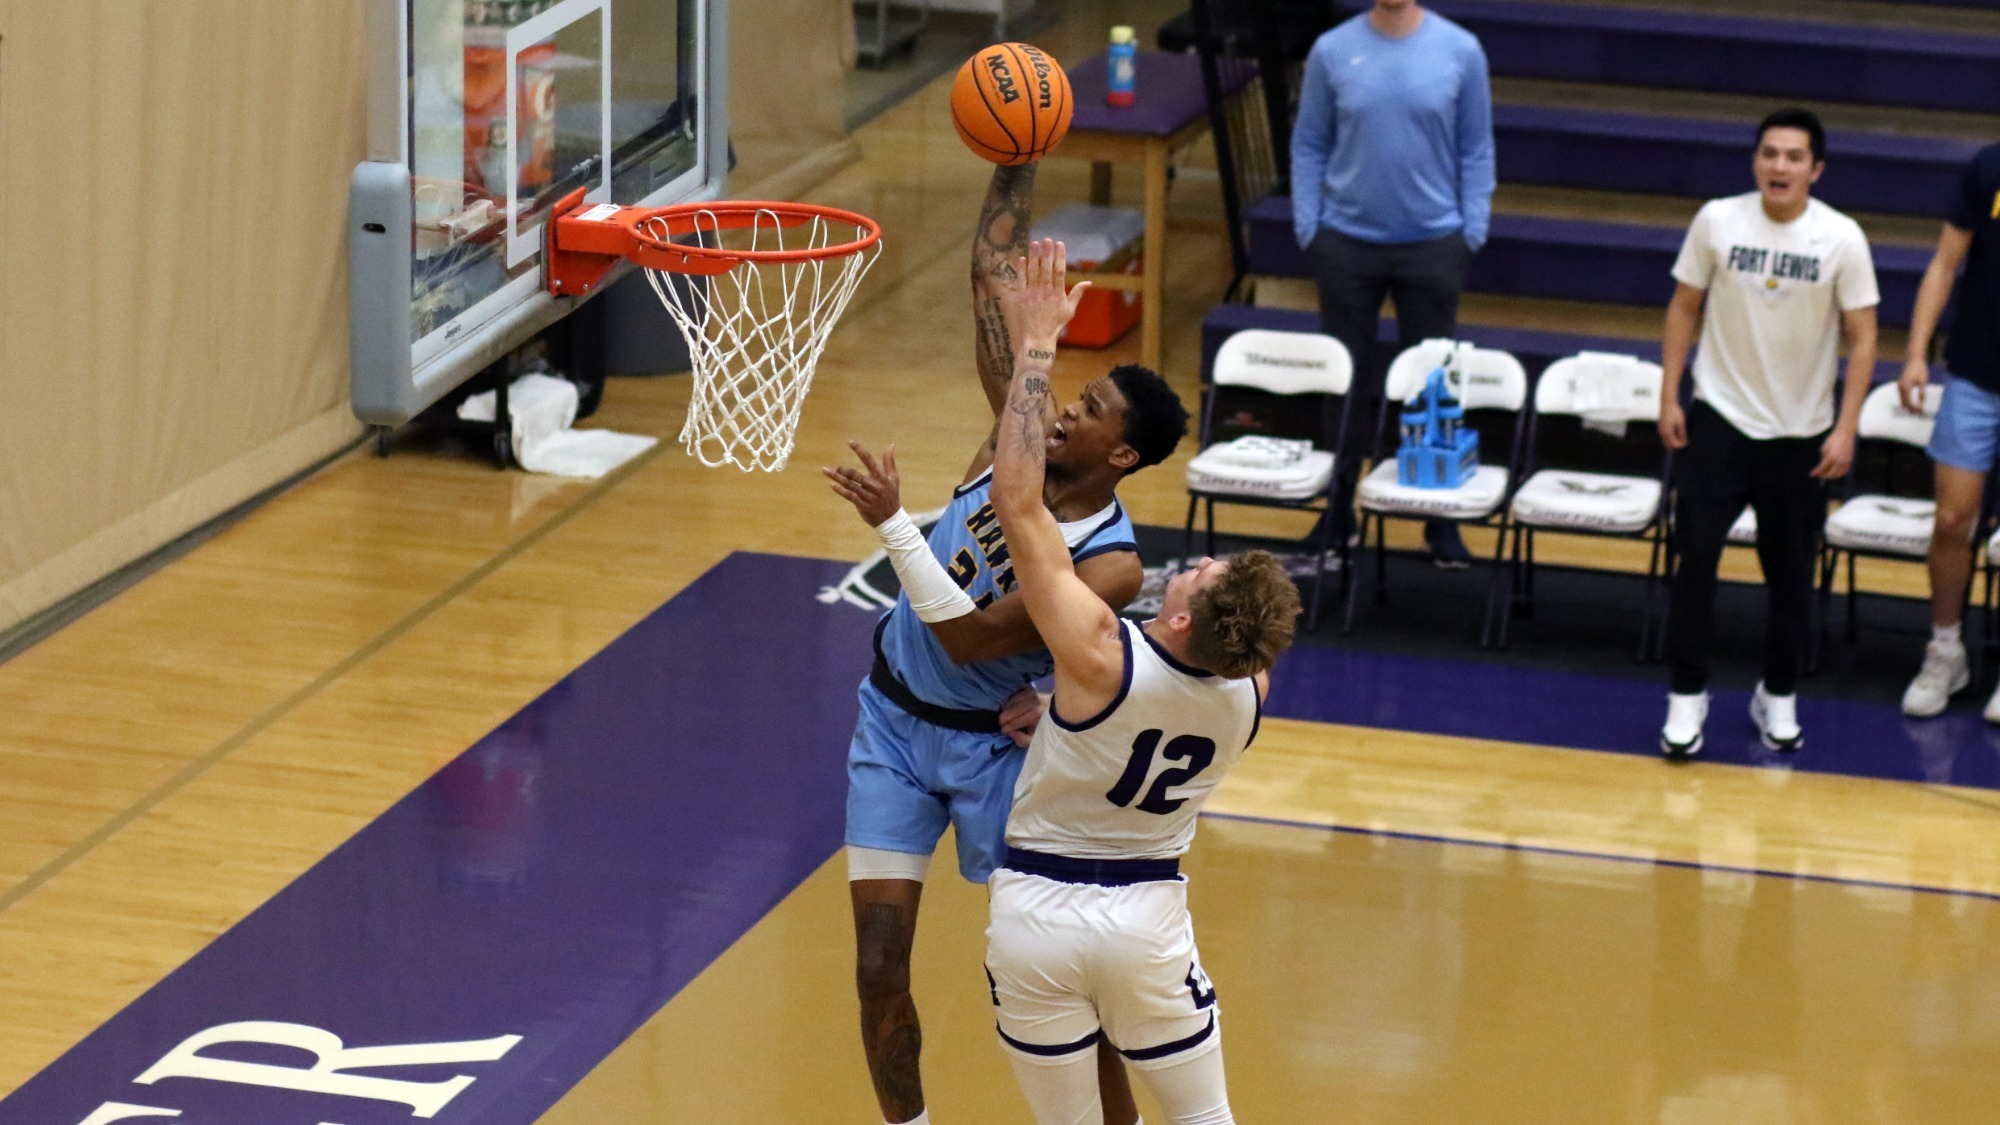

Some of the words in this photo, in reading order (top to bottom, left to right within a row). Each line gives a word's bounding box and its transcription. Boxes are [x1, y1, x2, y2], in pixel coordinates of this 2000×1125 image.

[986, 54, 1020, 104] NCAA
[1018, 44, 1051, 110] Wilson
[1727, 245, 1768, 274] FORT
[1772, 251, 1820, 282] LEWIS
[1105, 728, 1216, 815] 12
